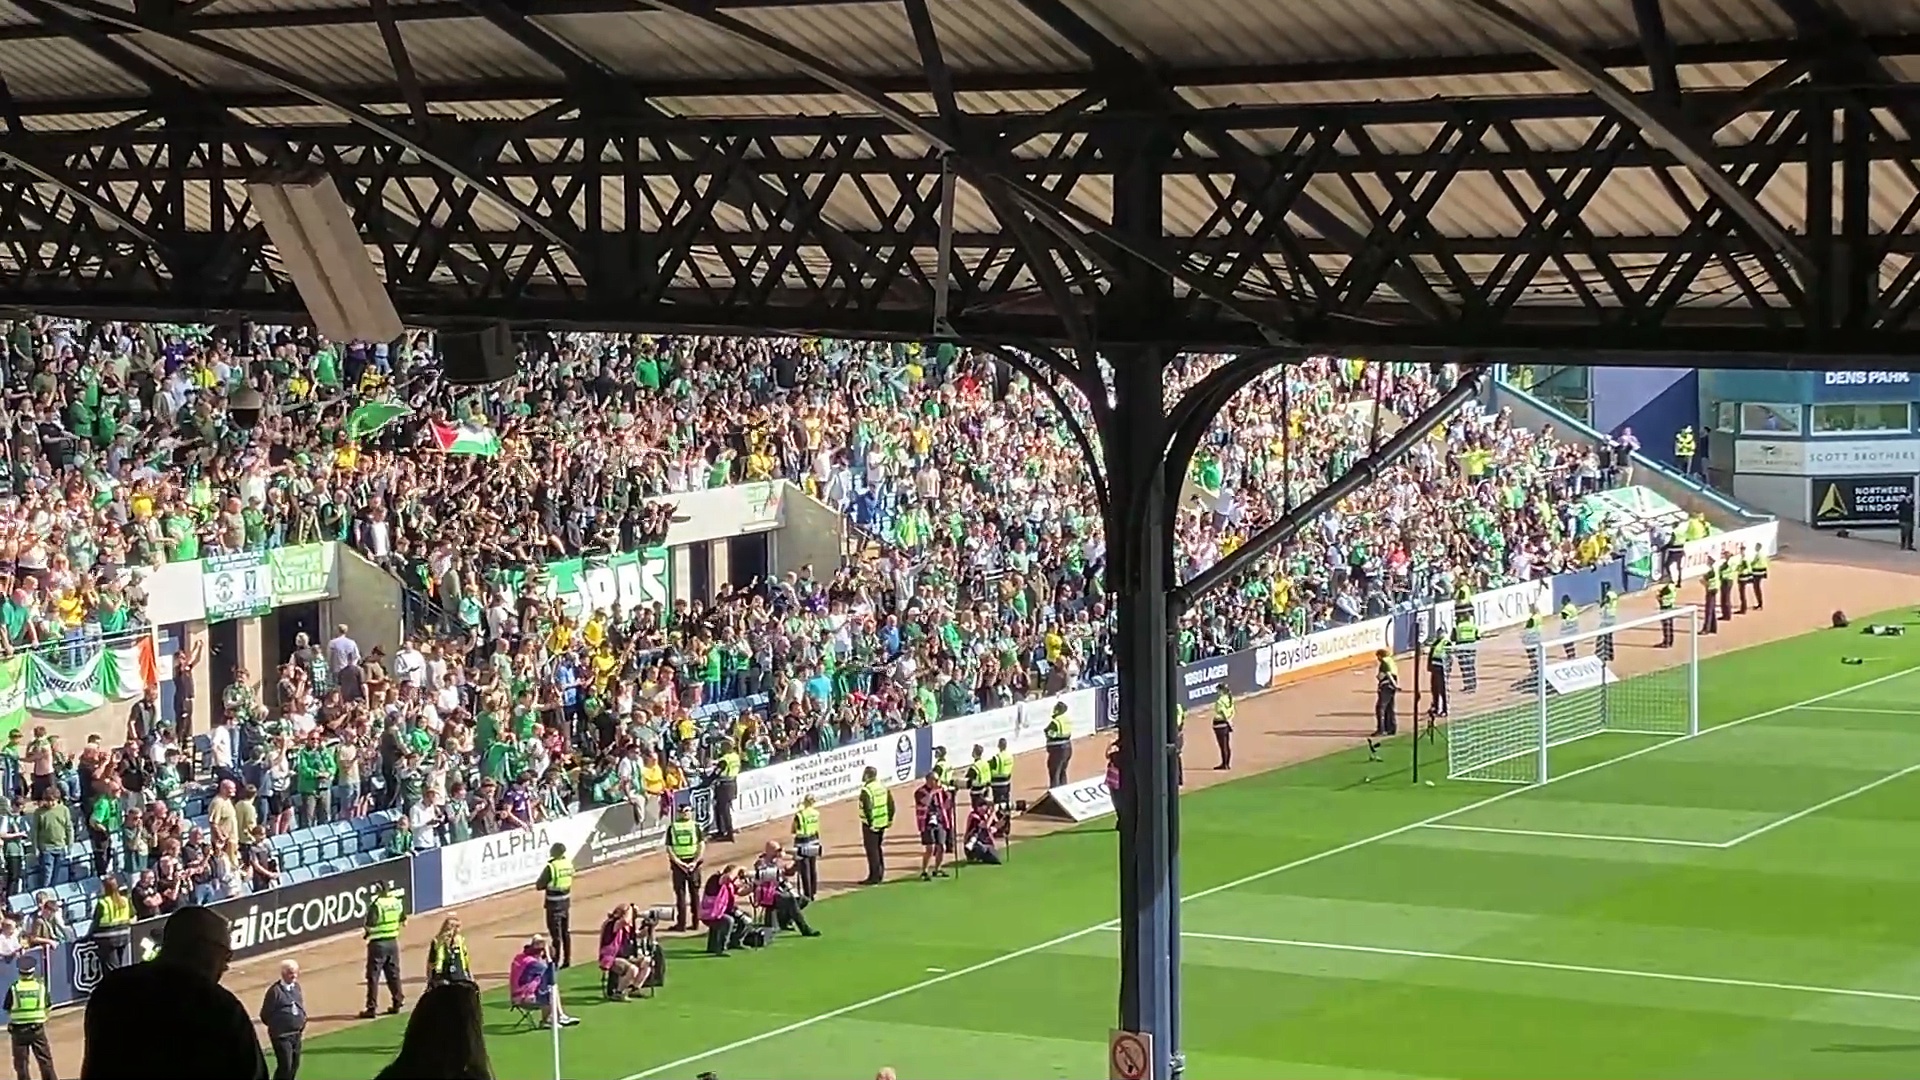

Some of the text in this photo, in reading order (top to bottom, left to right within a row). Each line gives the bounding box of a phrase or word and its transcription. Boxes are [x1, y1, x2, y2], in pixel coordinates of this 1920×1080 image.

[1825, 371, 1910, 385] DENS PARK
[1809, 453, 1849, 463] SCOTT
[1853, 451, 1916, 462] BROTHERS
[1855, 486, 1907, 495] NORTHERN
[1203, 663, 1229, 682] LAGER
[1554, 661, 1600, 681] CROWN
[795, 743, 878, 771] HOLIDAY HOMES FOR SALE
[819, 764, 847, 777] HOLIDAY
[848, 759, 866, 769] PARK
[481, 828, 550, 863] ALPHA
[259, 887, 367, 945] RECORDS
